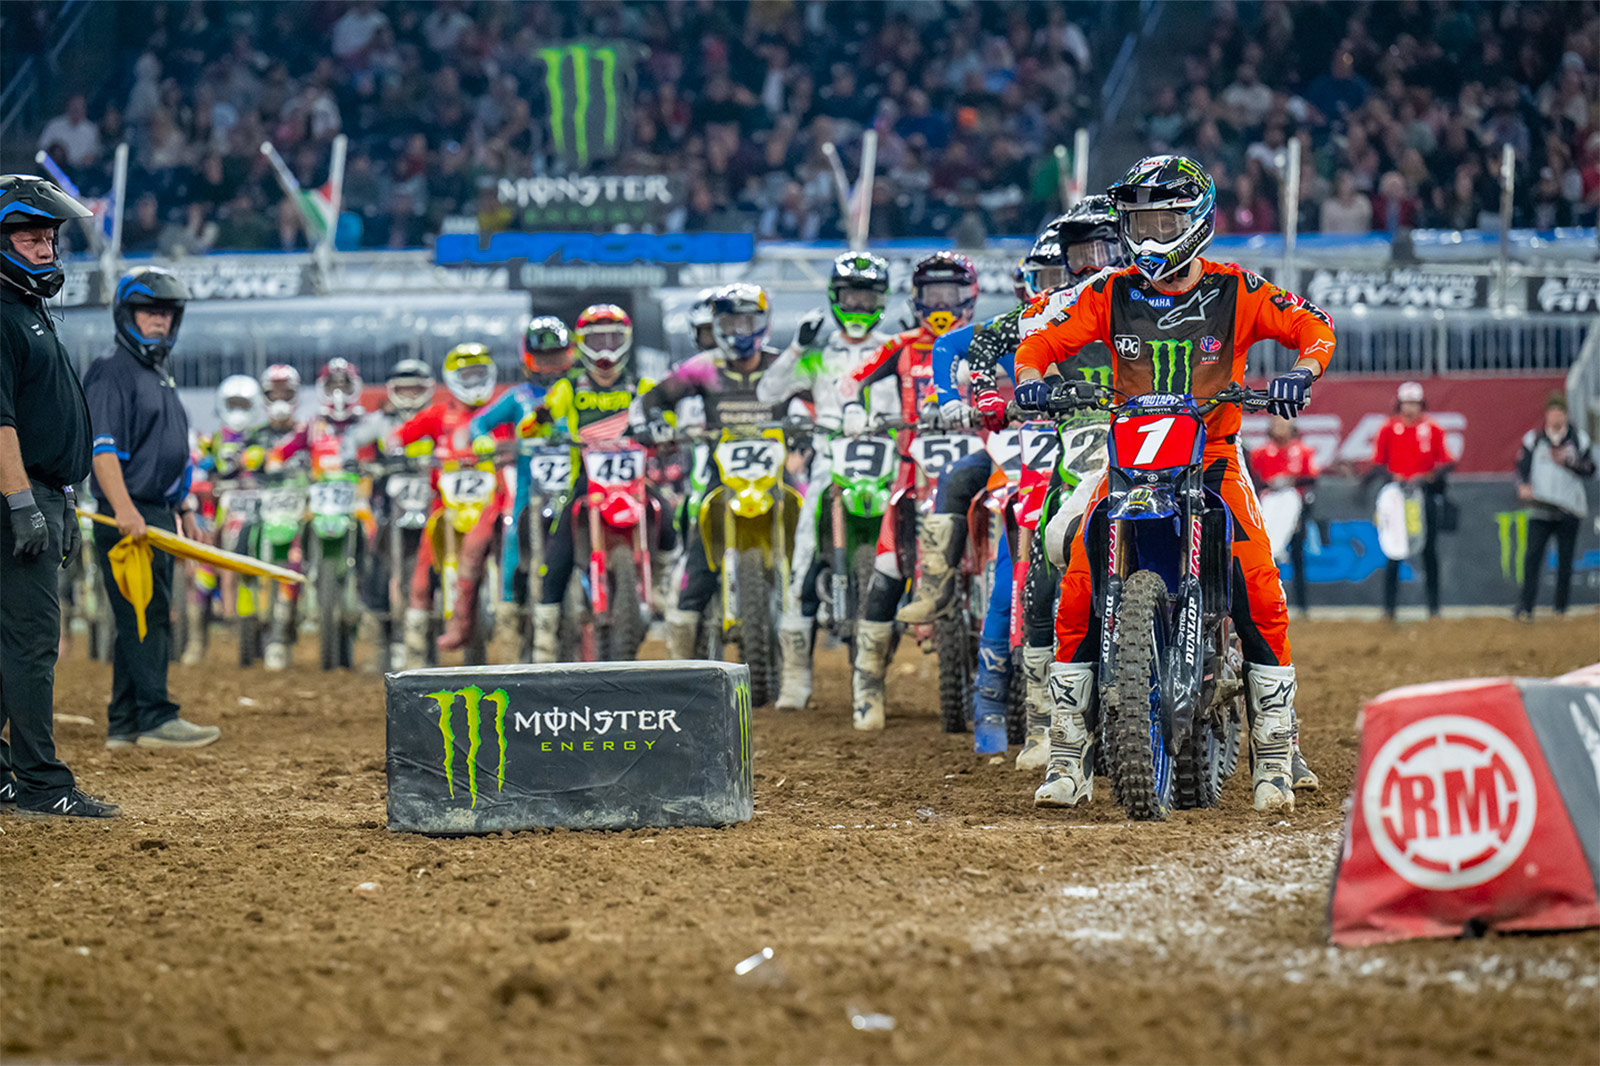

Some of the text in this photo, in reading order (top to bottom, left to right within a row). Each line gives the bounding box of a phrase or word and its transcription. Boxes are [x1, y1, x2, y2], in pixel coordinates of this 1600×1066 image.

[498, 175, 672, 207] MONSTER
[1132, 417, 1176, 466] 1
[596, 457, 636, 481] 45
[730, 446, 774, 472] 94
[844, 440, 887, 477] 9
[453, 476, 482, 495] 12
[1185, 596, 1198, 668] DUNLOP
[514, 707, 681, 736] MONSTER
[541, 740, 657, 752] ENERGY
[1400, 764, 1499, 842] RM
